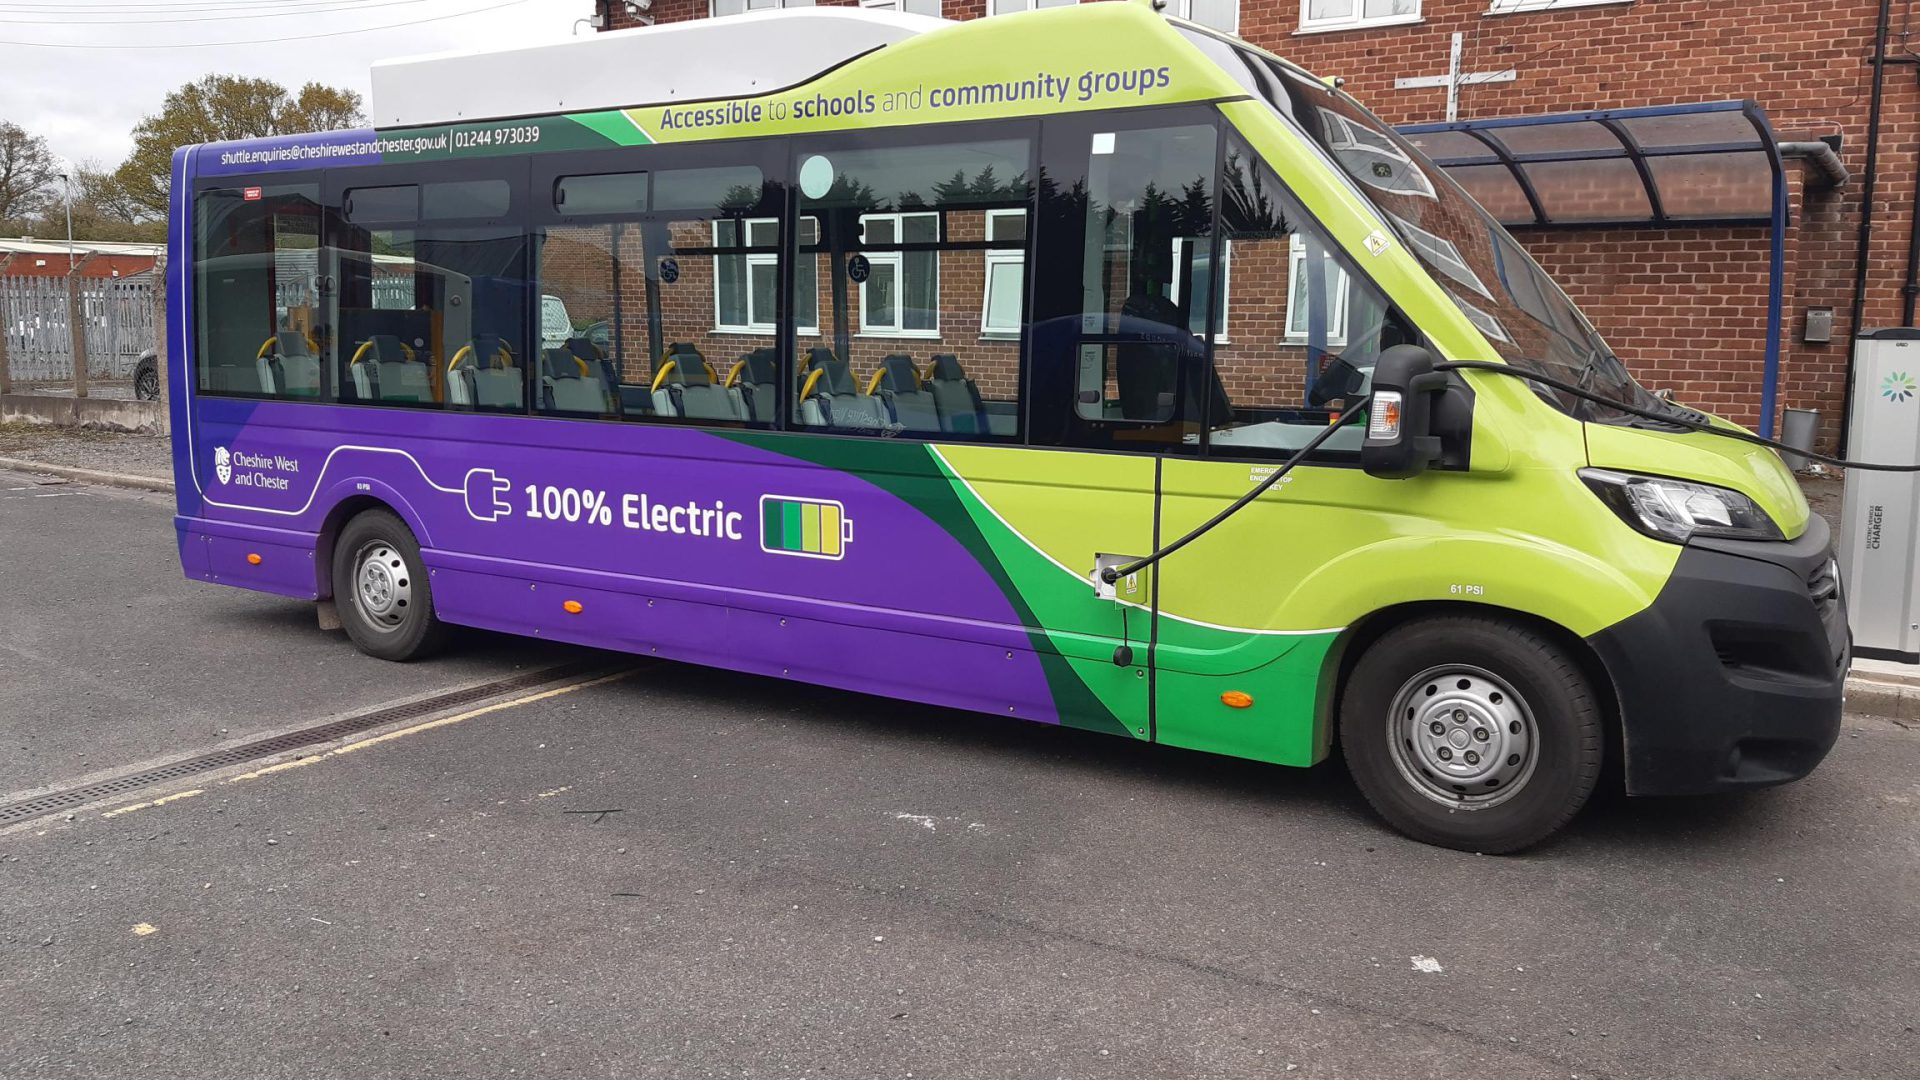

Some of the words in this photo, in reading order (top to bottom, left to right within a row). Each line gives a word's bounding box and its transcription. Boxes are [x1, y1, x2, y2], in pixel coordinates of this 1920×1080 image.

[660, 101, 762, 130] Accessible
[768, 99, 787, 122] to
[792, 89, 877, 120] schools
[882, 84, 922, 113] and
[930, 73, 1071, 108] community
[1078, 66, 1171, 101] groups
[221, 134, 447, 165] shuttle.enquiries@cheshirewestandchester.gov.uk
[455, 130, 492, 148] 01244
[495, 126, 540, 144] 973039
[233, 452, 274, 470] Cheshire
[275, 456, 299, 472] West
[235, 472, 253, 486] and
[253, 472, 290, 490] Chester
[525, 484, 612, 526] 100%
[622, 493, 743, 541] Electric
[1871, 505, 1883, 549] CHARGER
[1451, 584, 1463, 594] 61
[1465, 584, 1484, 595] PSI
